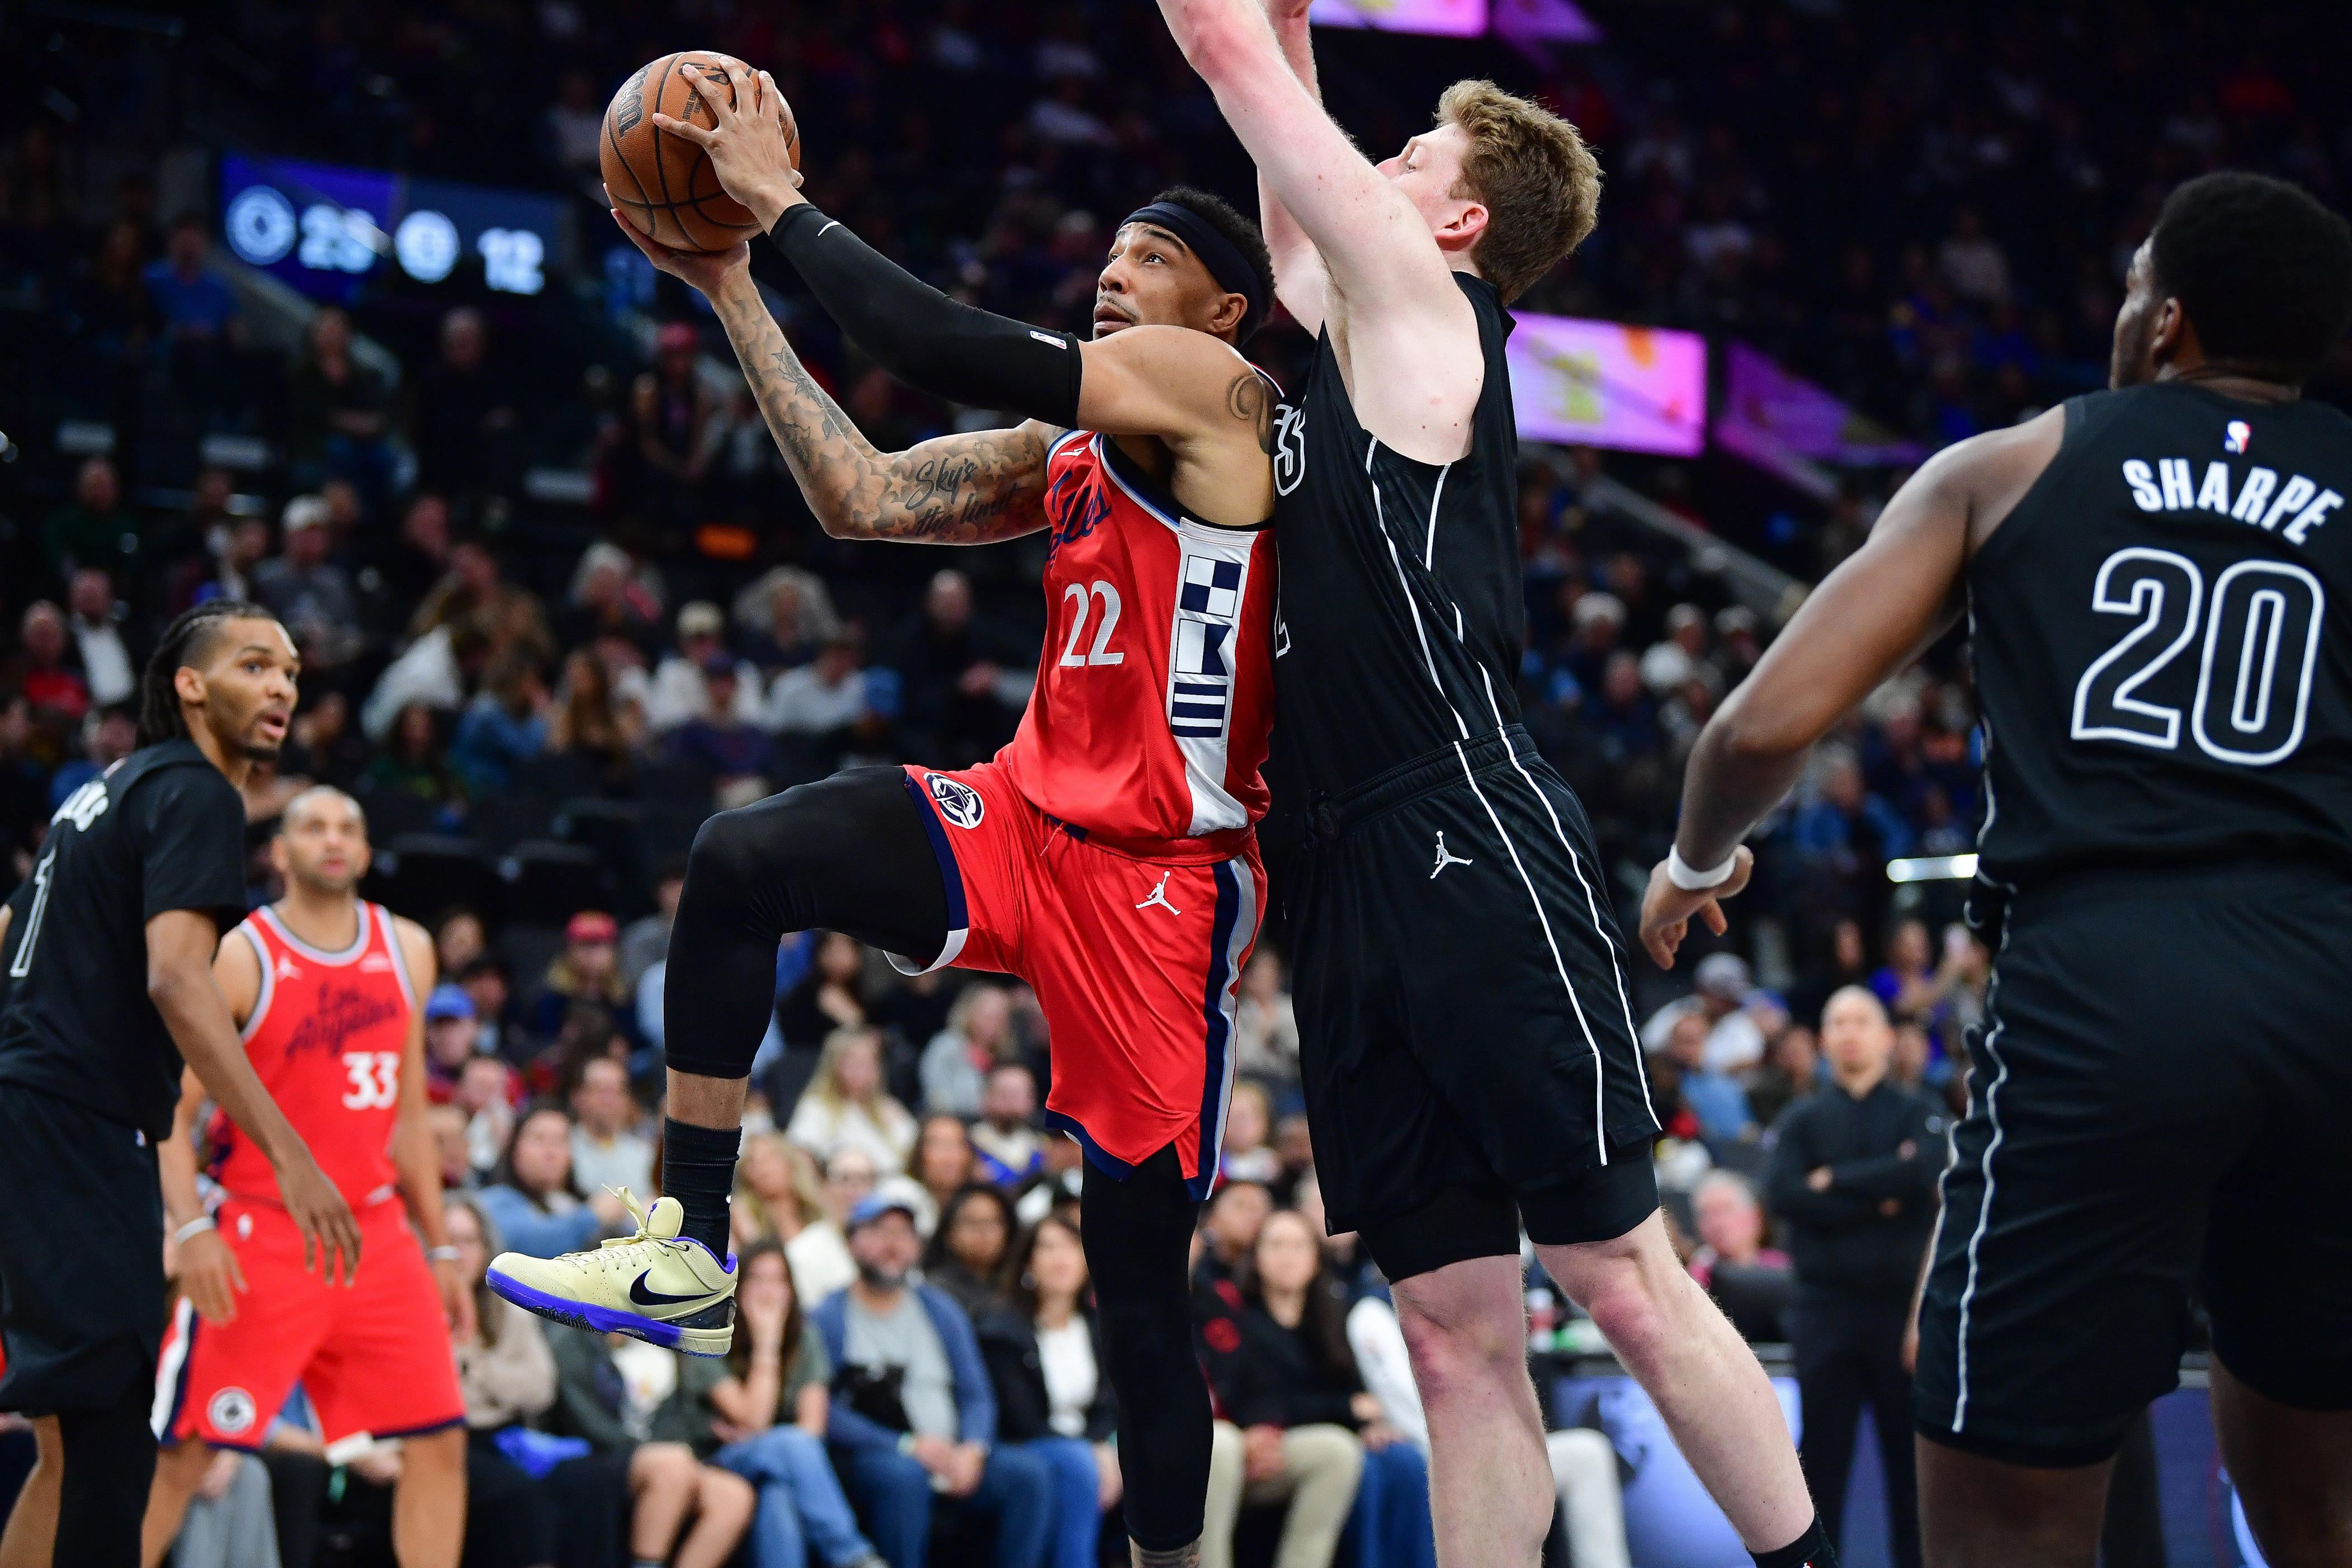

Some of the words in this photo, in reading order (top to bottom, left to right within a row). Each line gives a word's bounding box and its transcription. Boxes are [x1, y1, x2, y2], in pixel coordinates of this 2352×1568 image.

[905, 457, 977, 510] Sky's
[2122, 458, 2345, 545] SHARPE
[915, 505, 954, 536] the
[1059, 580, 1125, 668] 22
[2071, 547, 2325, 766] 20
[342, 1051, 399, 1110] 33
